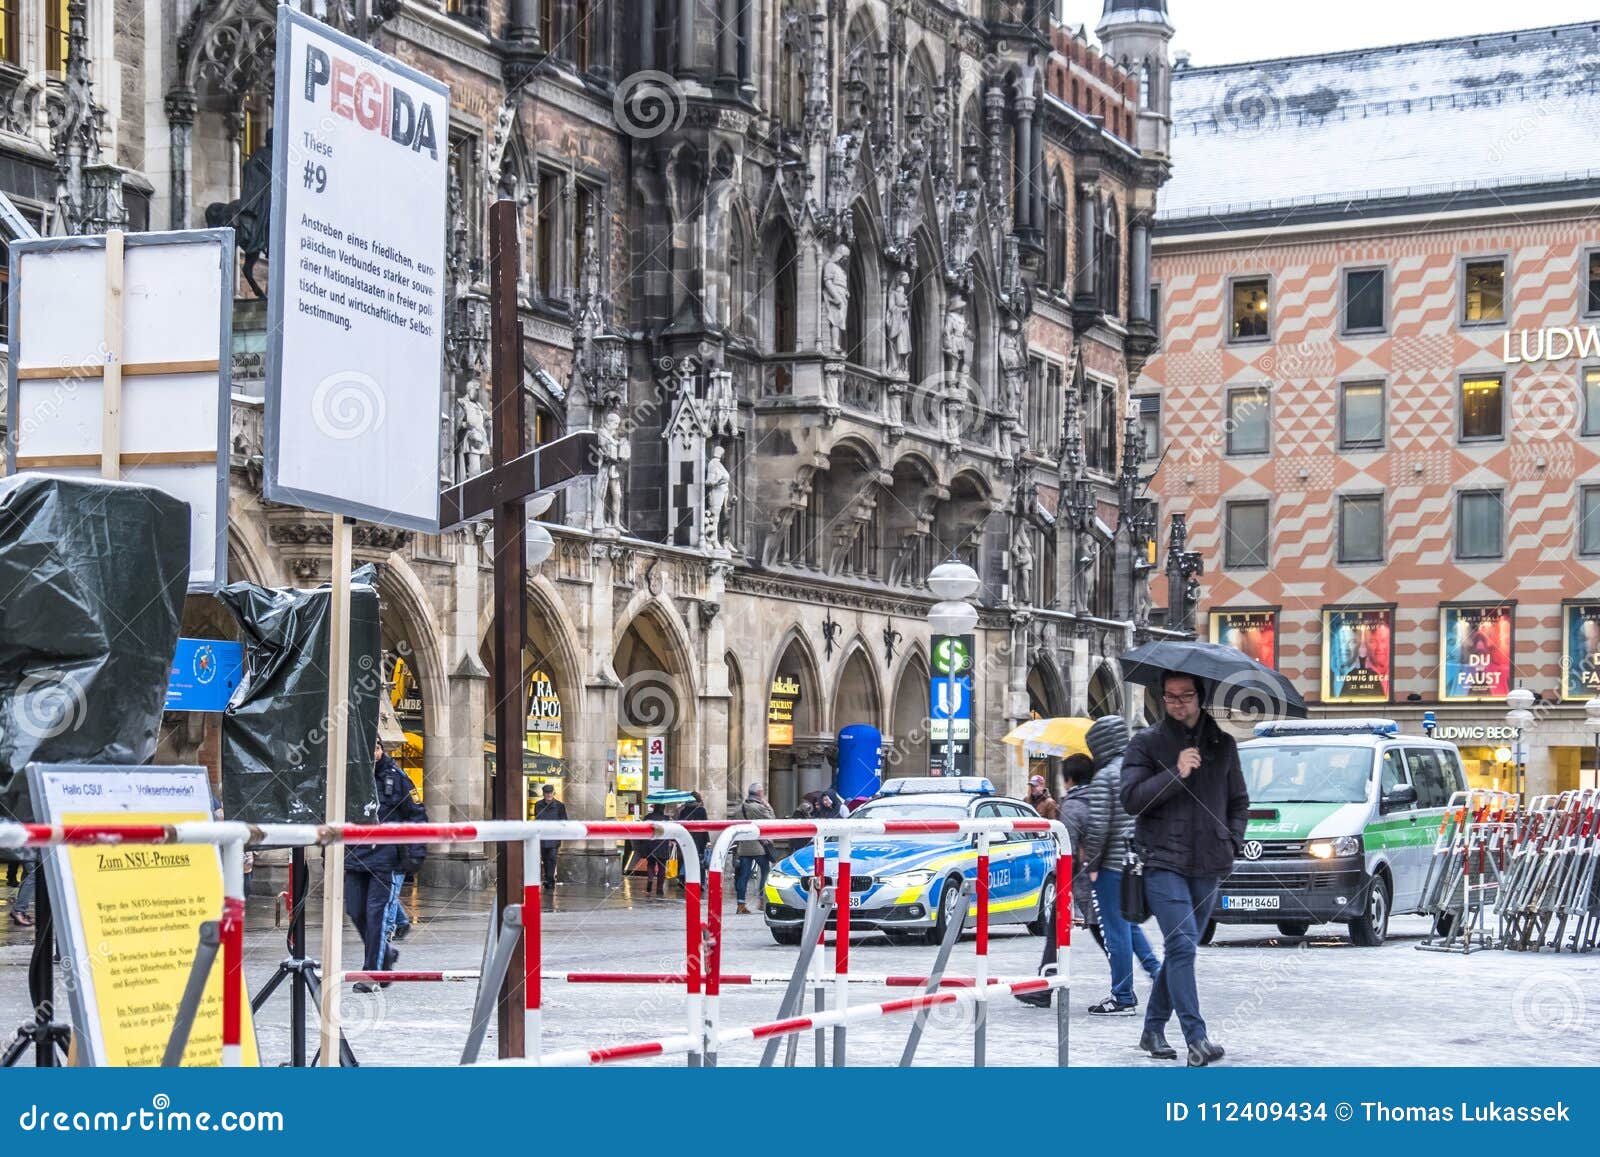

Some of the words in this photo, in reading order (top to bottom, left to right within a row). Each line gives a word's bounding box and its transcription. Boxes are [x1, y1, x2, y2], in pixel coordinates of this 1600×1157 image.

[304, 43, 438, 161] PEGIDA
[303, 131, 333, 158] These
[303, 160, 327, 193] #9
[301, 213, 343, 240] Anstreben
[347, 233, 368, 250] eines
[372, 240, 414, 270] friedlichen,
[417, 262, 436, 276] euro-
[301, 236, 336, 259] päischen
[339, 249, 381, 276] Verbundes
[383, 268, 410, 288] starker
[412, 281, 435, 296] souve-
[300, 257, 321, 275] räner
[324, 264, 386, 299] Nationalstaaten
[388, 289, 395, 303] in
[397, 292, 416, 311] freier
[419, 303, 434, 317] poli-
[299, 278, 327, 298] tischer
[330, 291, 345, 305] und
[348, 297, 407, 327] wirtschaftlicher
[409, 318, 434, 336] Selbst-
[299, 298, 352, 331] bestimmung.
[1503, 325, 1600, 363] LUDW
[1470, 654, 1490, 666] DU
[537, 680, 557, 697] RA
[1458, 671, 1502, 684] FAUST
[938, 682, 962, 714] U
[1434, 726, 1485, 739] LUDWIG
[1486, 726, 1519, 739] BECK
[62, 784, 81, 795] Hallo
[97, 854, 123, 870] Zum
[125, 851, 190, 869] NSU-Prozess
[988, 868, 1011, 889] OLIZEI
[1229, 898, 1235, 907] M
[1242, 898, 1253, 907] PM
[1255, 898, 1277, 907] 8460
